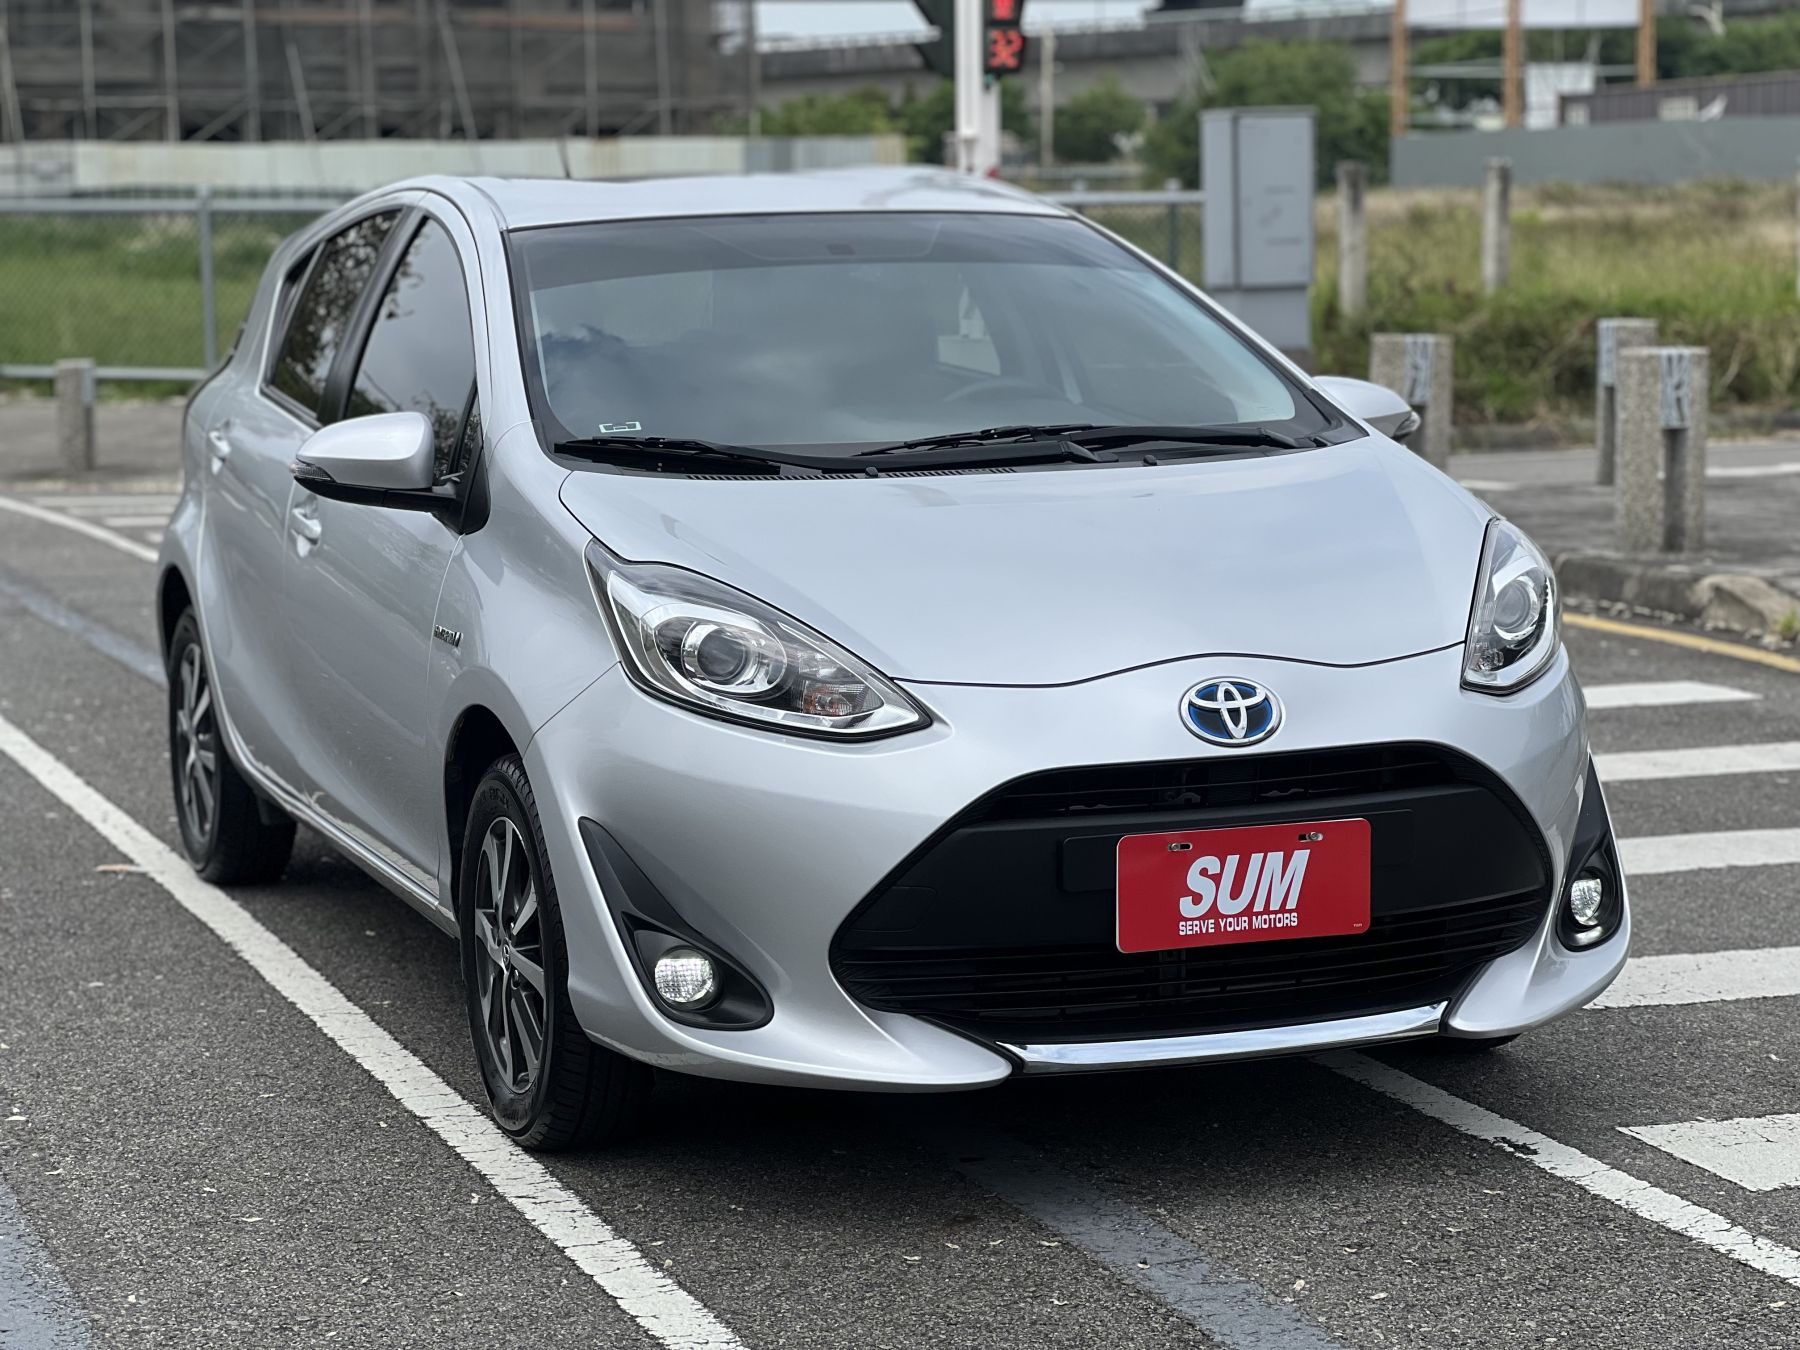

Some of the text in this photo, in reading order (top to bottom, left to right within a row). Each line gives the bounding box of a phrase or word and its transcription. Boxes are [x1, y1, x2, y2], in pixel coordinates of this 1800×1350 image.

[1179, 849, 1310, 918] SUM
[1179, 912, 1298, 935] SERVE YOUR MOTORS
